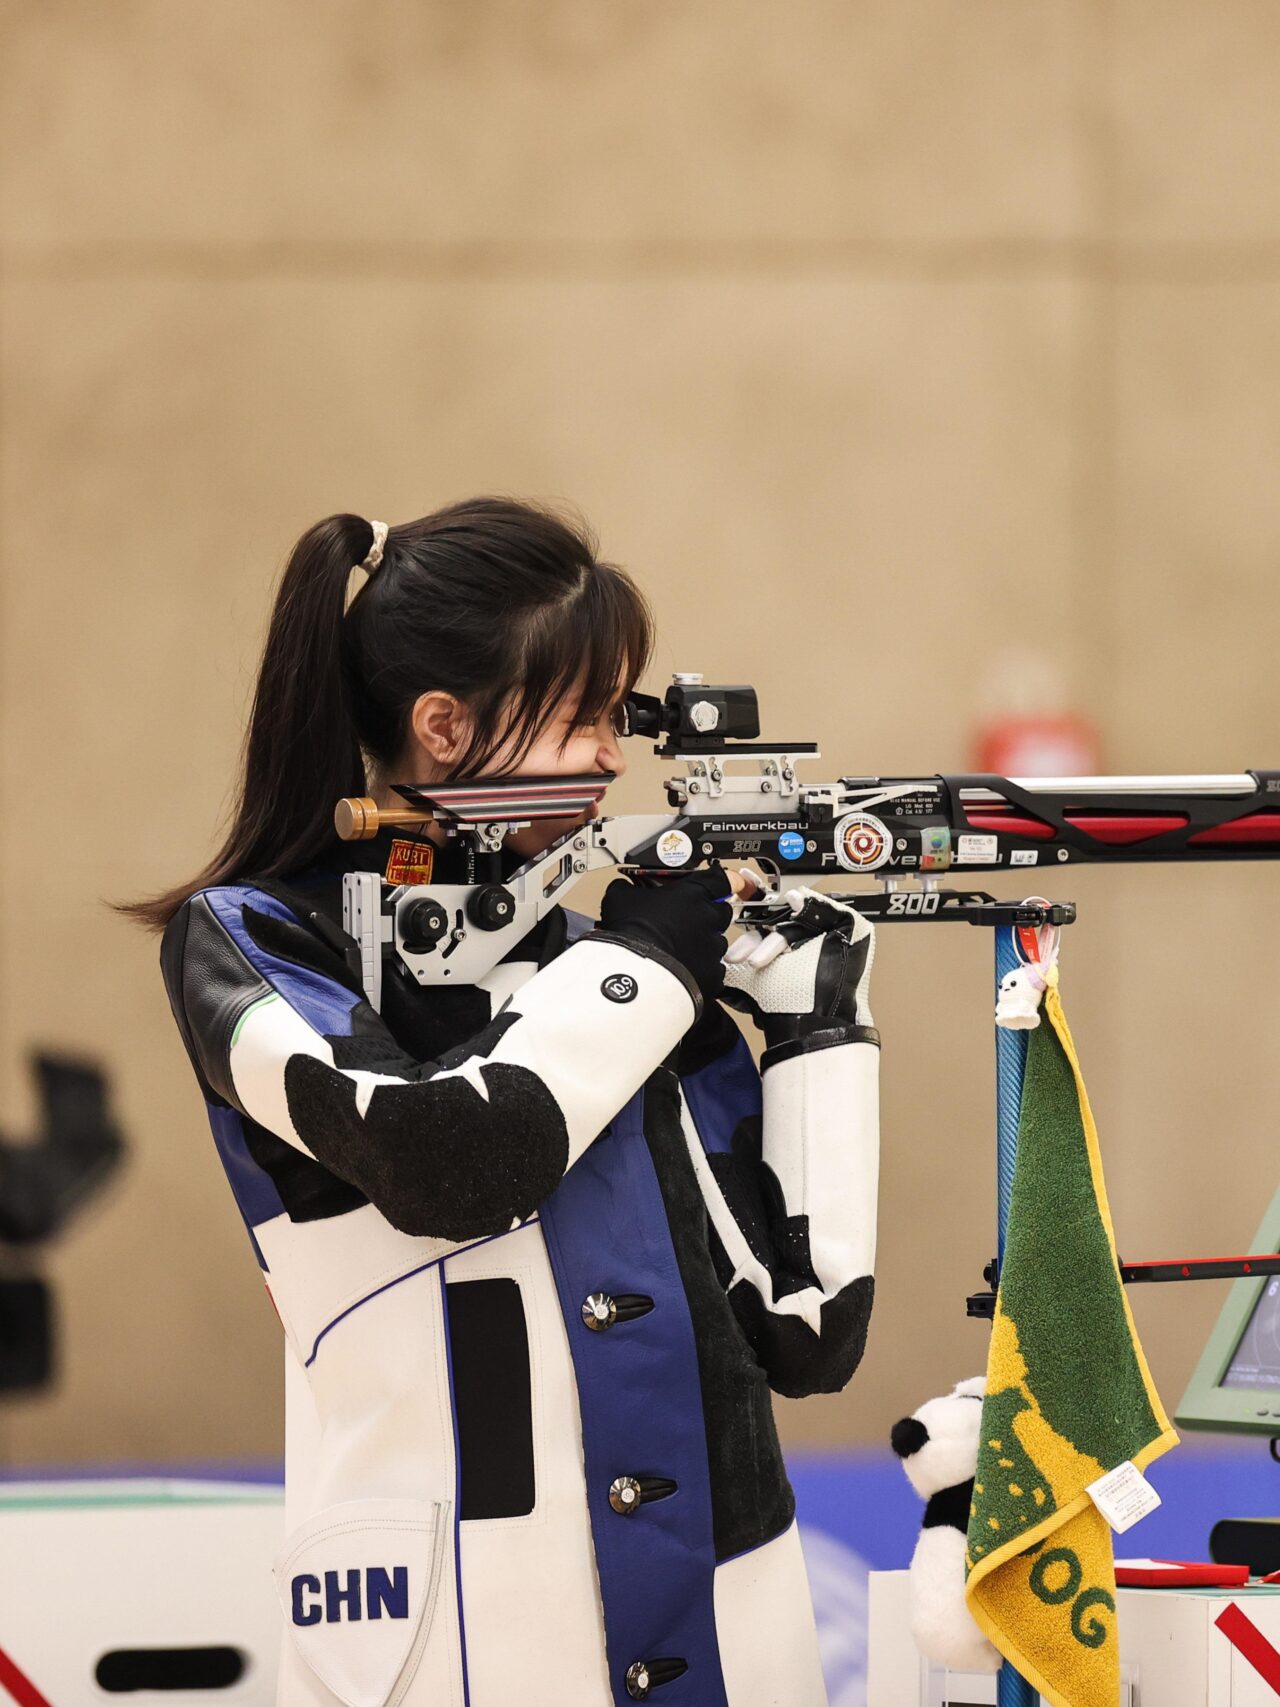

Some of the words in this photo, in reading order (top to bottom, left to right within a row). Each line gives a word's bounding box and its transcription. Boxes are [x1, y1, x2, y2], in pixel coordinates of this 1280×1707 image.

[703, 821, 809, 831] Feinwerkbau
[395, 847, 428, 865] KURT
[732, 840, 762, 853] 800
[886, 893, 940, 915] 800
[610, 976, 633, 996] 10.9
[1268, 1281, 1279, 1297] 6
[291, 1566, 409, 1627] CHN
[1028, 1547, 1116, 1649] OG
